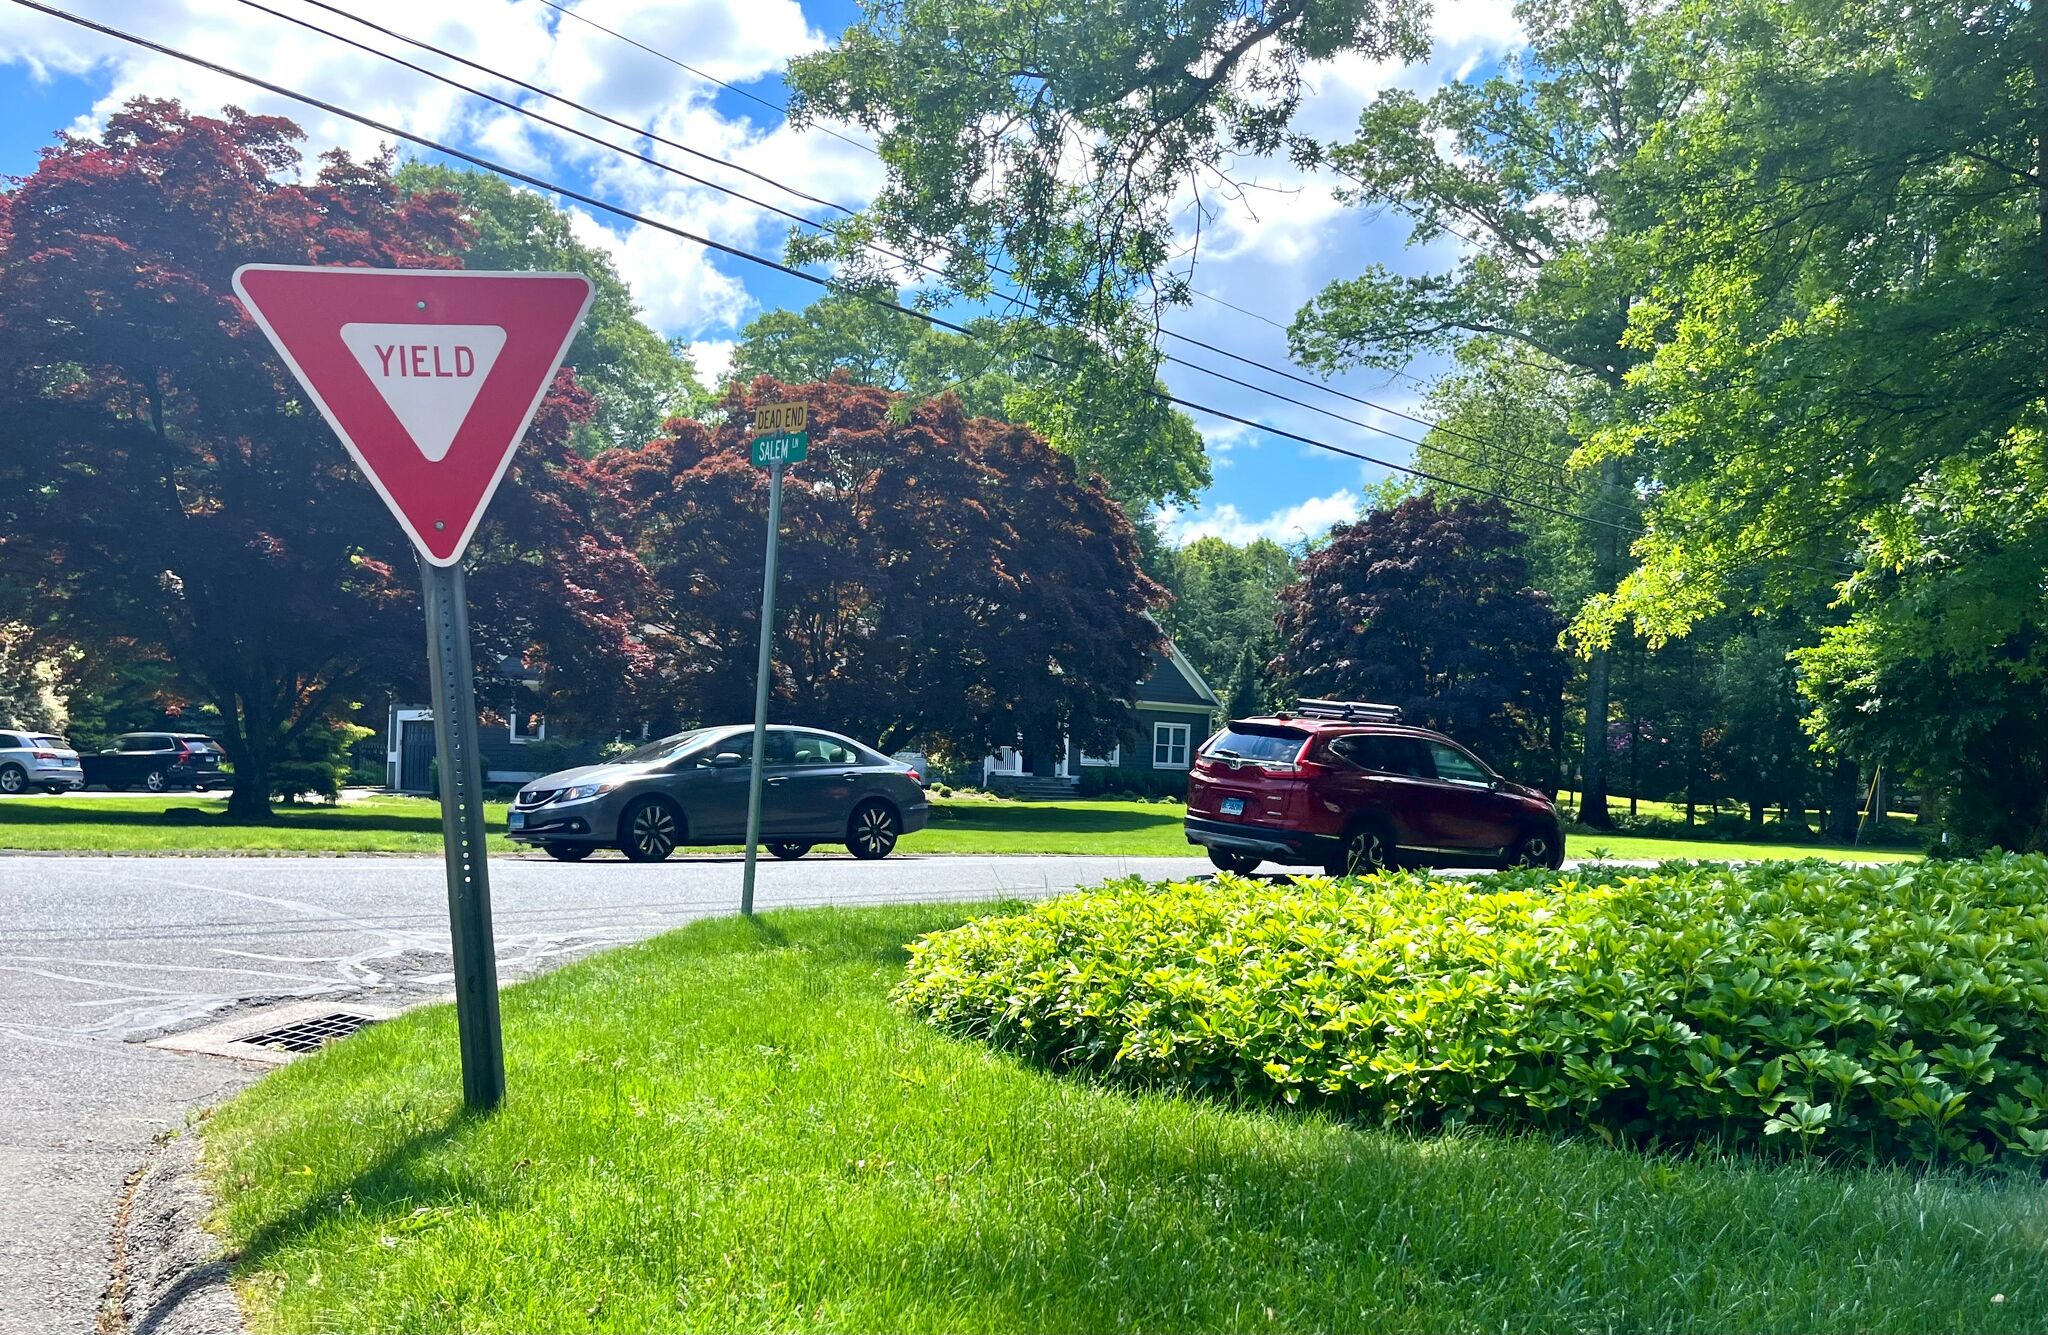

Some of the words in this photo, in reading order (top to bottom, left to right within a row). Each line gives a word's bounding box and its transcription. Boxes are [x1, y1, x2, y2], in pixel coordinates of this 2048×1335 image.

[374, 344, 475, 377] YIELD
[757, 409, 782, 430] DEAD
[785, 406, 804, 427] END
[758, 438, 789, 461] SALEM
[791, 437, 799, 448] LN
